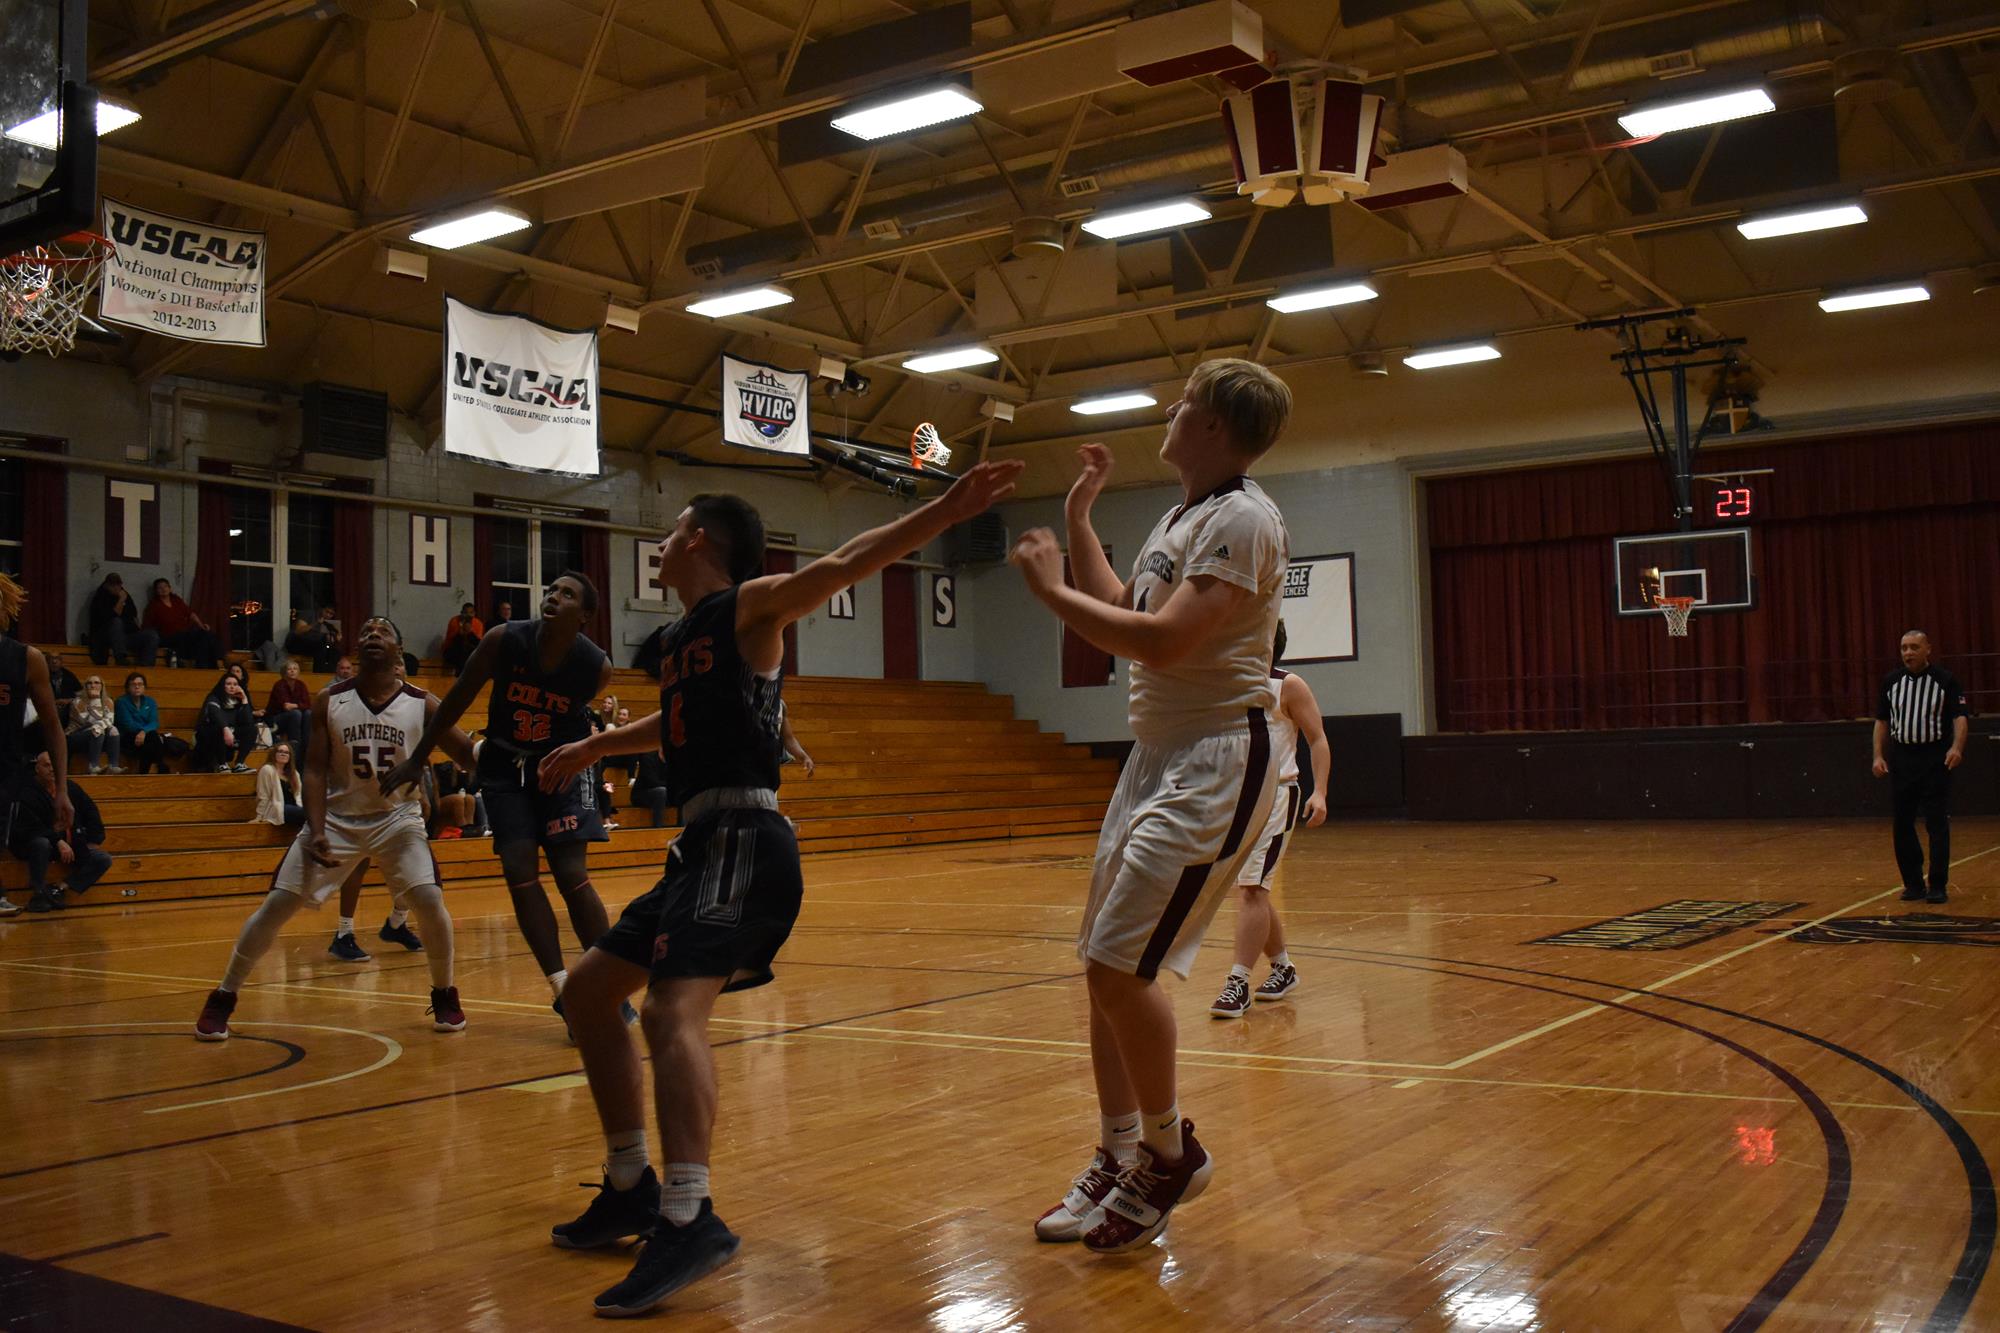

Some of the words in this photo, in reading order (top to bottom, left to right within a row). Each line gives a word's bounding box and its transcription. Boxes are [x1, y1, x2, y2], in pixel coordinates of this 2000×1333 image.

[112, 211, 258, 270] USCAA
[113, 250, 176, 283] National
[181, 270, 258, 297] Champions
[111, 274, 167, 302] Women's
[195, 298, 259, 316] Basketball
[152, 310, 217, 332] 2012-2013
[454, 351, 591, 411] USCAA
[492, 404, 528, 418] COLLEGIATE
[528, 412, 551, 423] ATHLETIC
[741, 391, 795, 420] HVIAC
[1715, 488, 1751, 518] 23
[110, 480, 155, 559] T
[412, 515, 448, 583] H
[935, 577, 953, 625] S
[1284, 567, 1309, 586] EGE
[506, 681, 571, 715] COLTS
[343, 723, 405, 747] PANTHERS
[512, 709, 551, 743] 32
[352, 746, 396, 780] 55
[546, 815, 579, 837] COLTS
